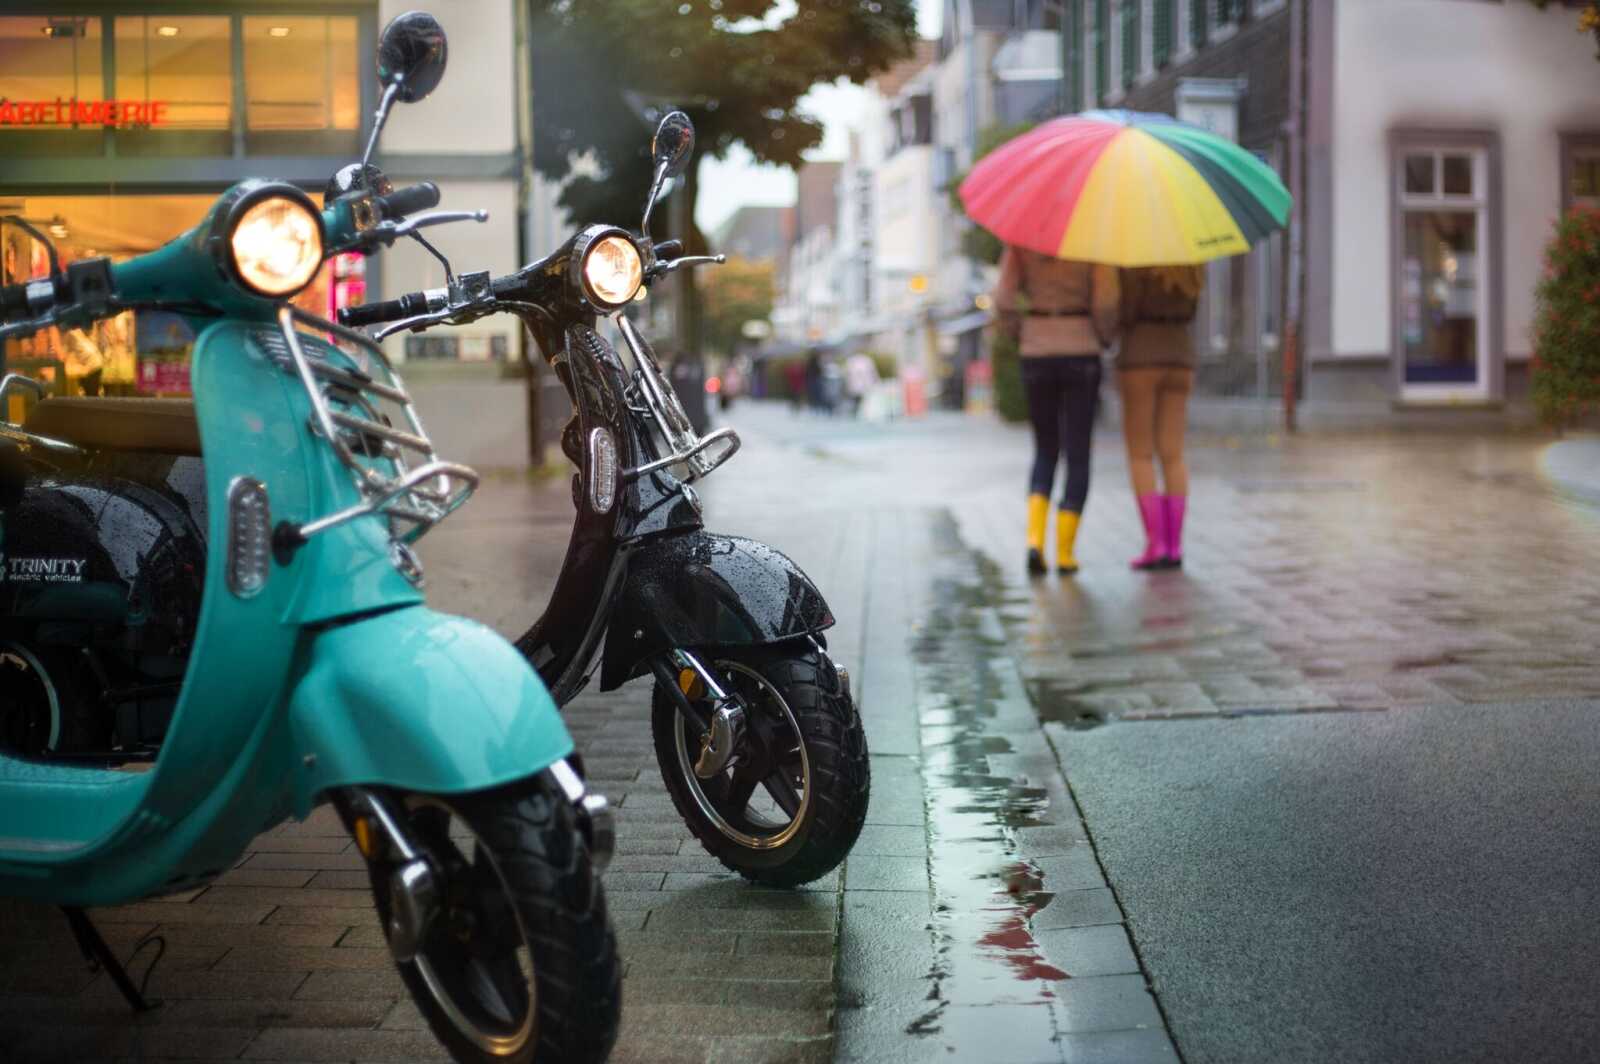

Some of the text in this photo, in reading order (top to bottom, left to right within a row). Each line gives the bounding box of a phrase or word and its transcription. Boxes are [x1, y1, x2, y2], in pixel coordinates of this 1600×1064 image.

[9, 558, 86, 573] TRINITY
[9, 573, 81, 582] electric vehicles
